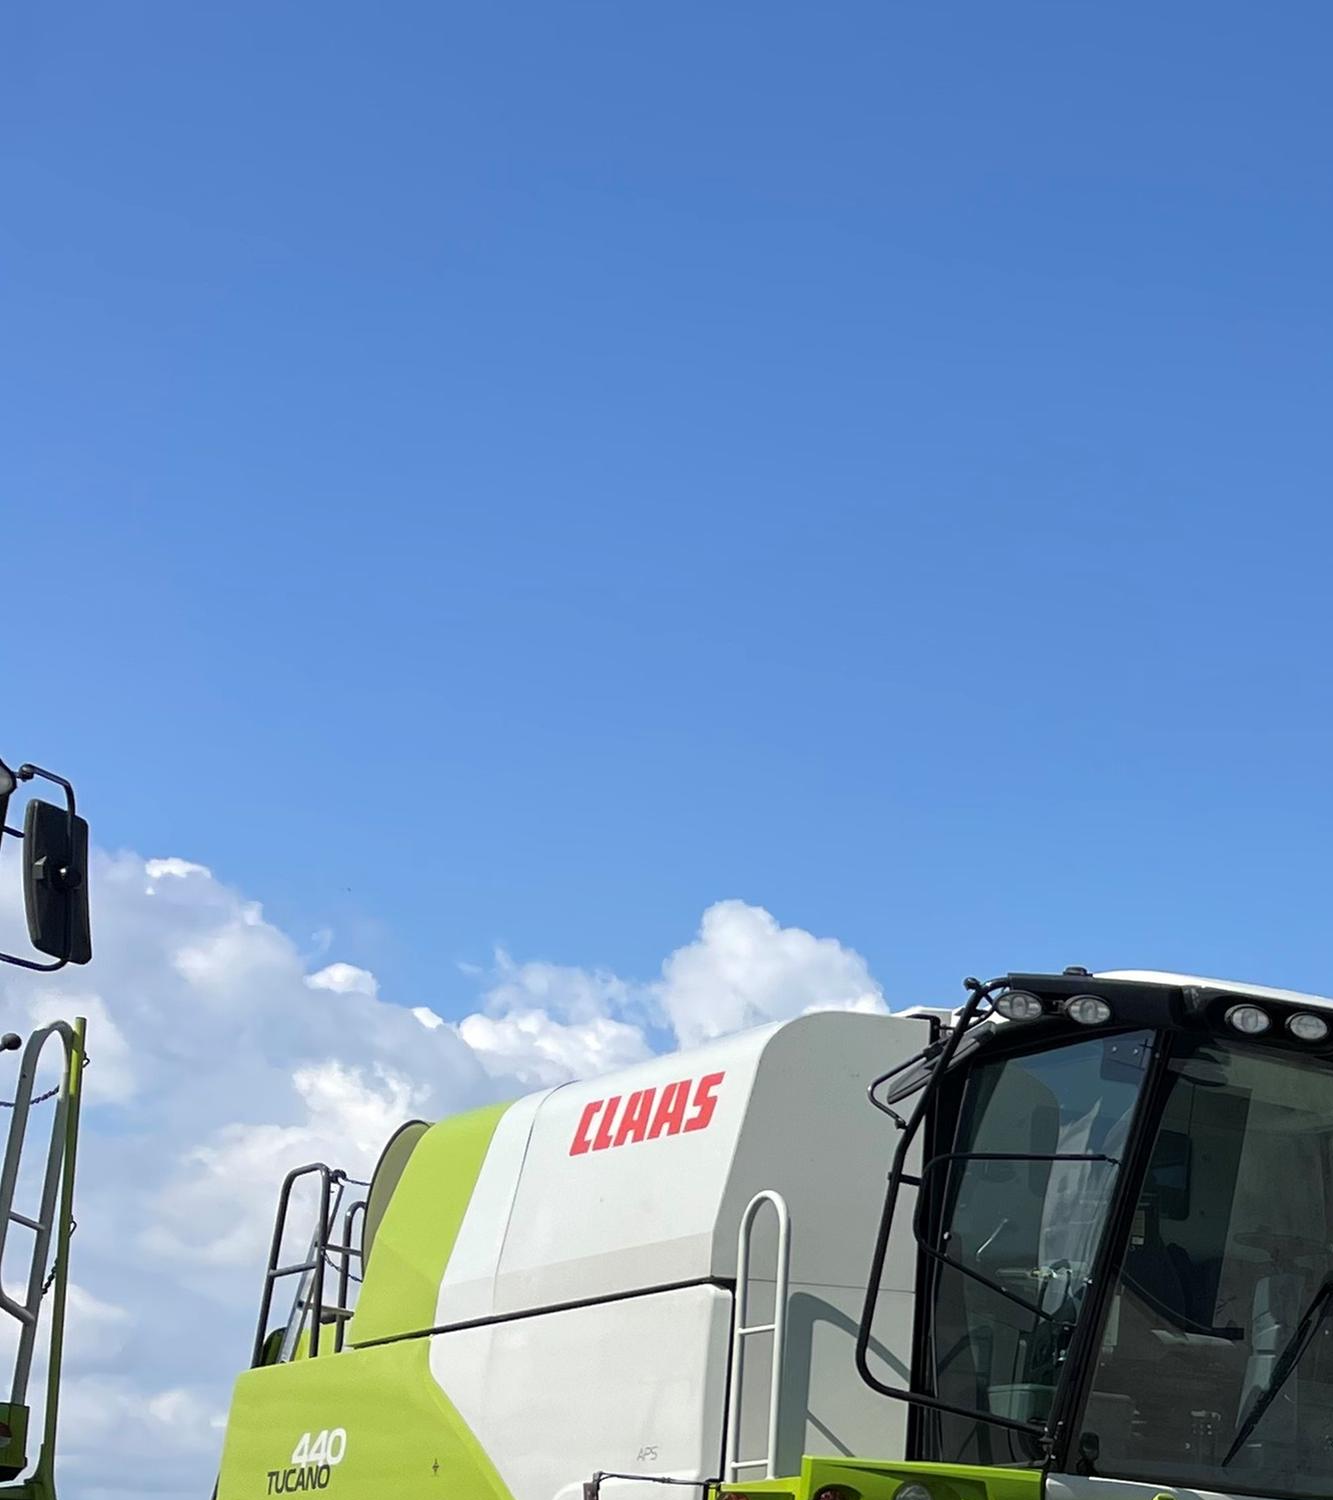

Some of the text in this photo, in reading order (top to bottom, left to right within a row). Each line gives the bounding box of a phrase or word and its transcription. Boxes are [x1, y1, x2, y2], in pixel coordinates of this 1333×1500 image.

[569, 1071, 726, 1156] CLAAS
[291, 1427, 347, 1468] 440
[636, 1446, 658, 1461] APS
[267, 1464, 331, 1495] TUCANO
